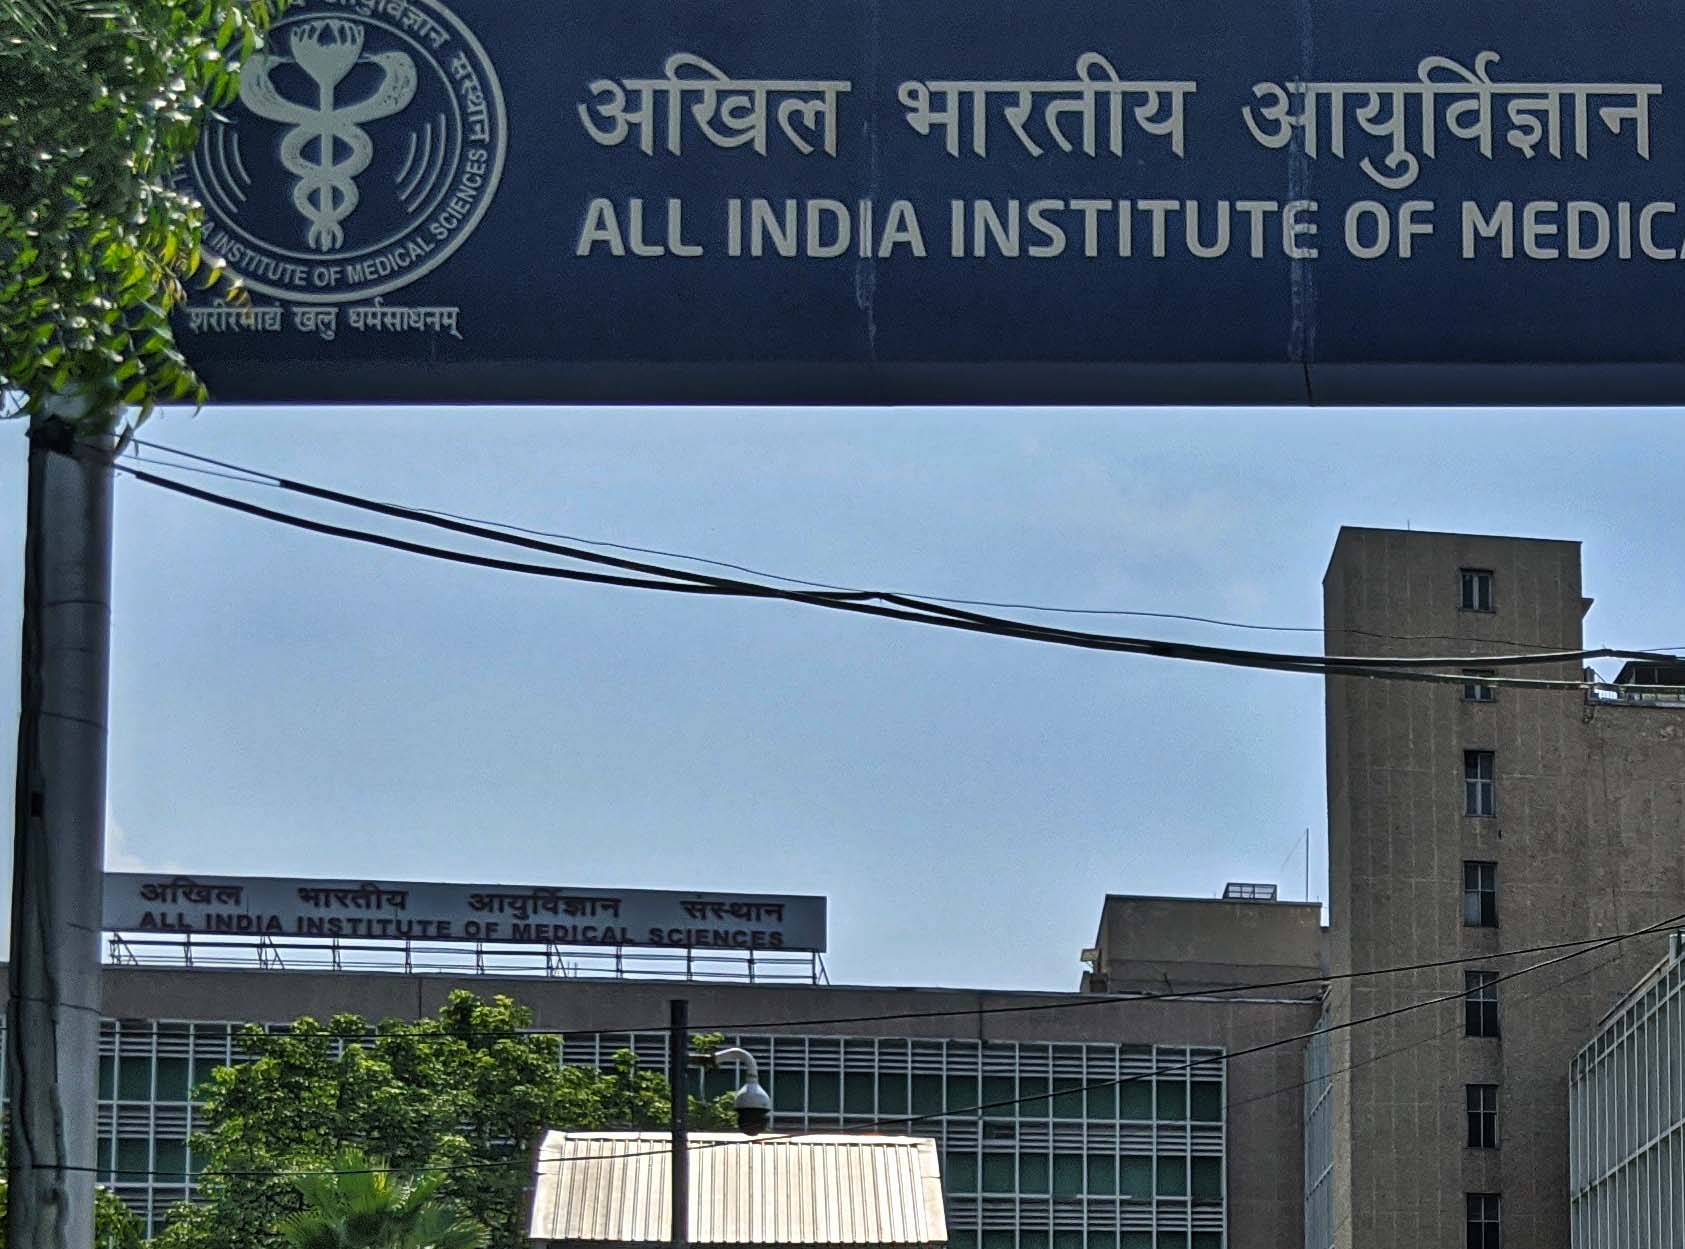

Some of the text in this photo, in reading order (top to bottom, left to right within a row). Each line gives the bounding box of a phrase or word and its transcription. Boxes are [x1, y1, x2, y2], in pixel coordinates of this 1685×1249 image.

[578, 53, 851, 157] अखिल
[898, 52, 1197, 158] भारतीय
[1242, 51, 1663, 189] आयुर्विज्ञान
[210, 230, 308, 286] INSTITUTE
[314, 266, 342, 287] OF
[345, 237, 436, 285] MEDICAL
[429, 147, 488, 241] SCIENCES
[576, 198, 704, 257] ALL
[728, 199, 928, 258] INDIA
[950, 199, 1319, 259] INSTITUTE
[1344, 200, 1435, 259] OF
[294, 306, 338, 341] खलु
[139, 875, 785, 922] अखिल भारतीय आयुर्विज्ञान संस्थान
[139, 911, 784, 947] ALL INDIA INSTITUTE OF MEDICAL SCIENCES
